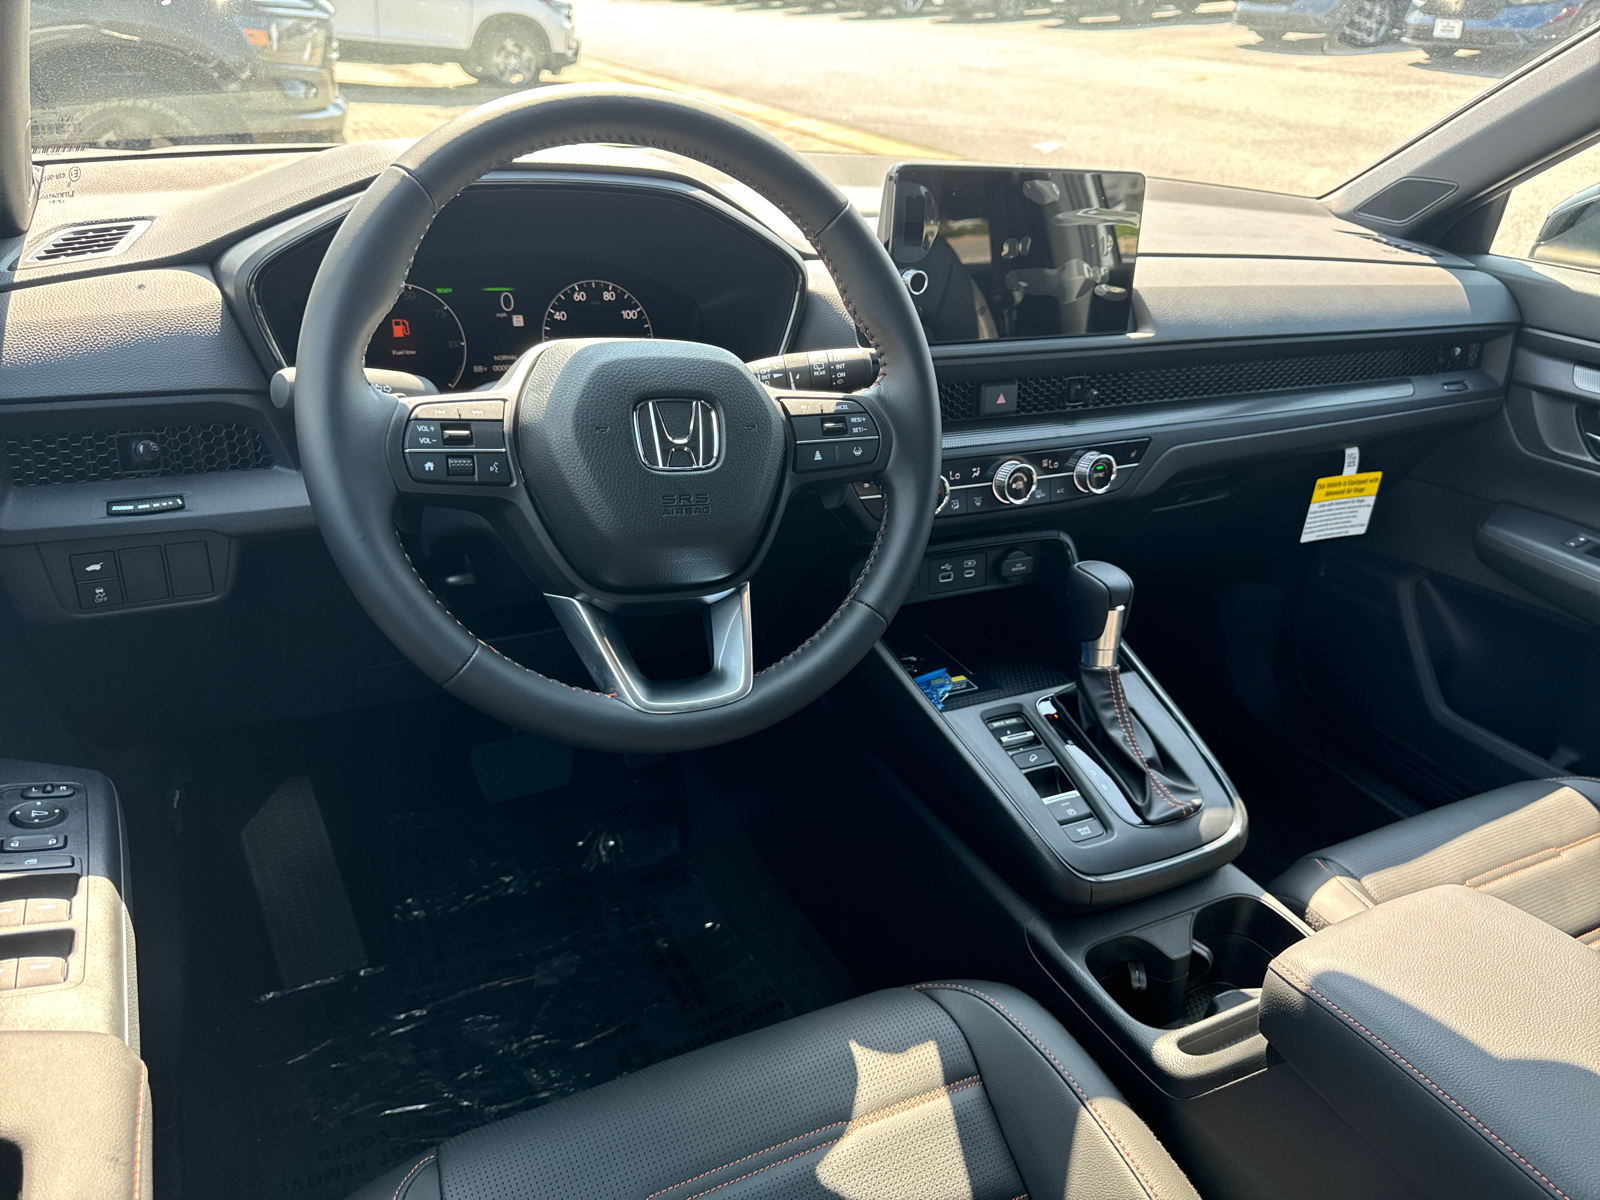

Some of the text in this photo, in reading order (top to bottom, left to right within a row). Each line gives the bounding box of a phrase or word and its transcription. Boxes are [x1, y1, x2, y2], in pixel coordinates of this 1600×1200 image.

[573, 291, 587, 301] 60
[603, 291, 616, 301] 80
[500, 292, 514, 311] 0
[553, 311, 567, 321] 40
[621, 310, 638, 319] 100
[662, 494, 710, 505] SRS
[661, 507, 712, 517] AIRBAG
